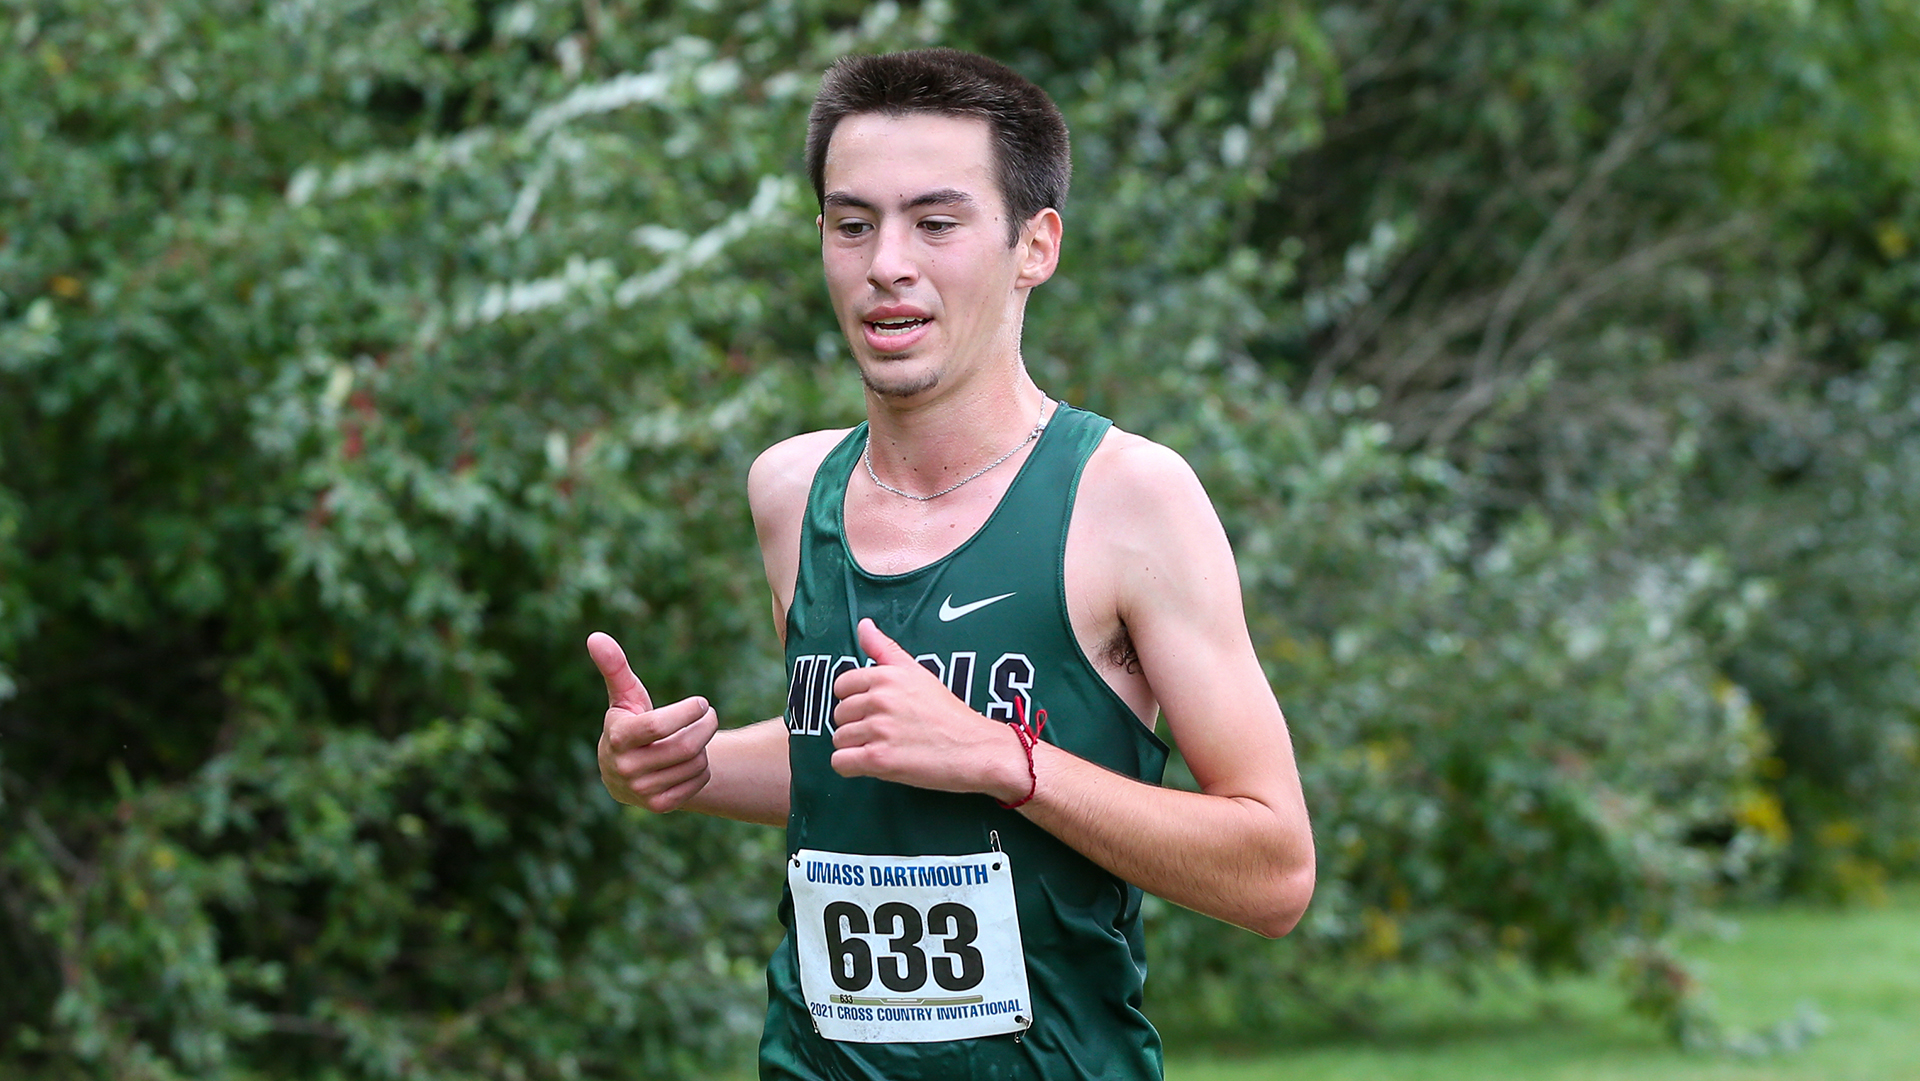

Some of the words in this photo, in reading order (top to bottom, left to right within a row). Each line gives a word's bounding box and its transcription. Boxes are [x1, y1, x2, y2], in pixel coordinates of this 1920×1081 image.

[807, 861, 865, 886] UMASS
[870, 864, 989, 887] DARTMOUTH
[823, 901, 984, 992] 633
[810, 1002, 834, 1018] 2021
[837, 1006, 873, 1021] CROSS
[877, 1007, 932, 1022] COUNTRY
[936, 999, 1023, 1020] INVITATIONAL
